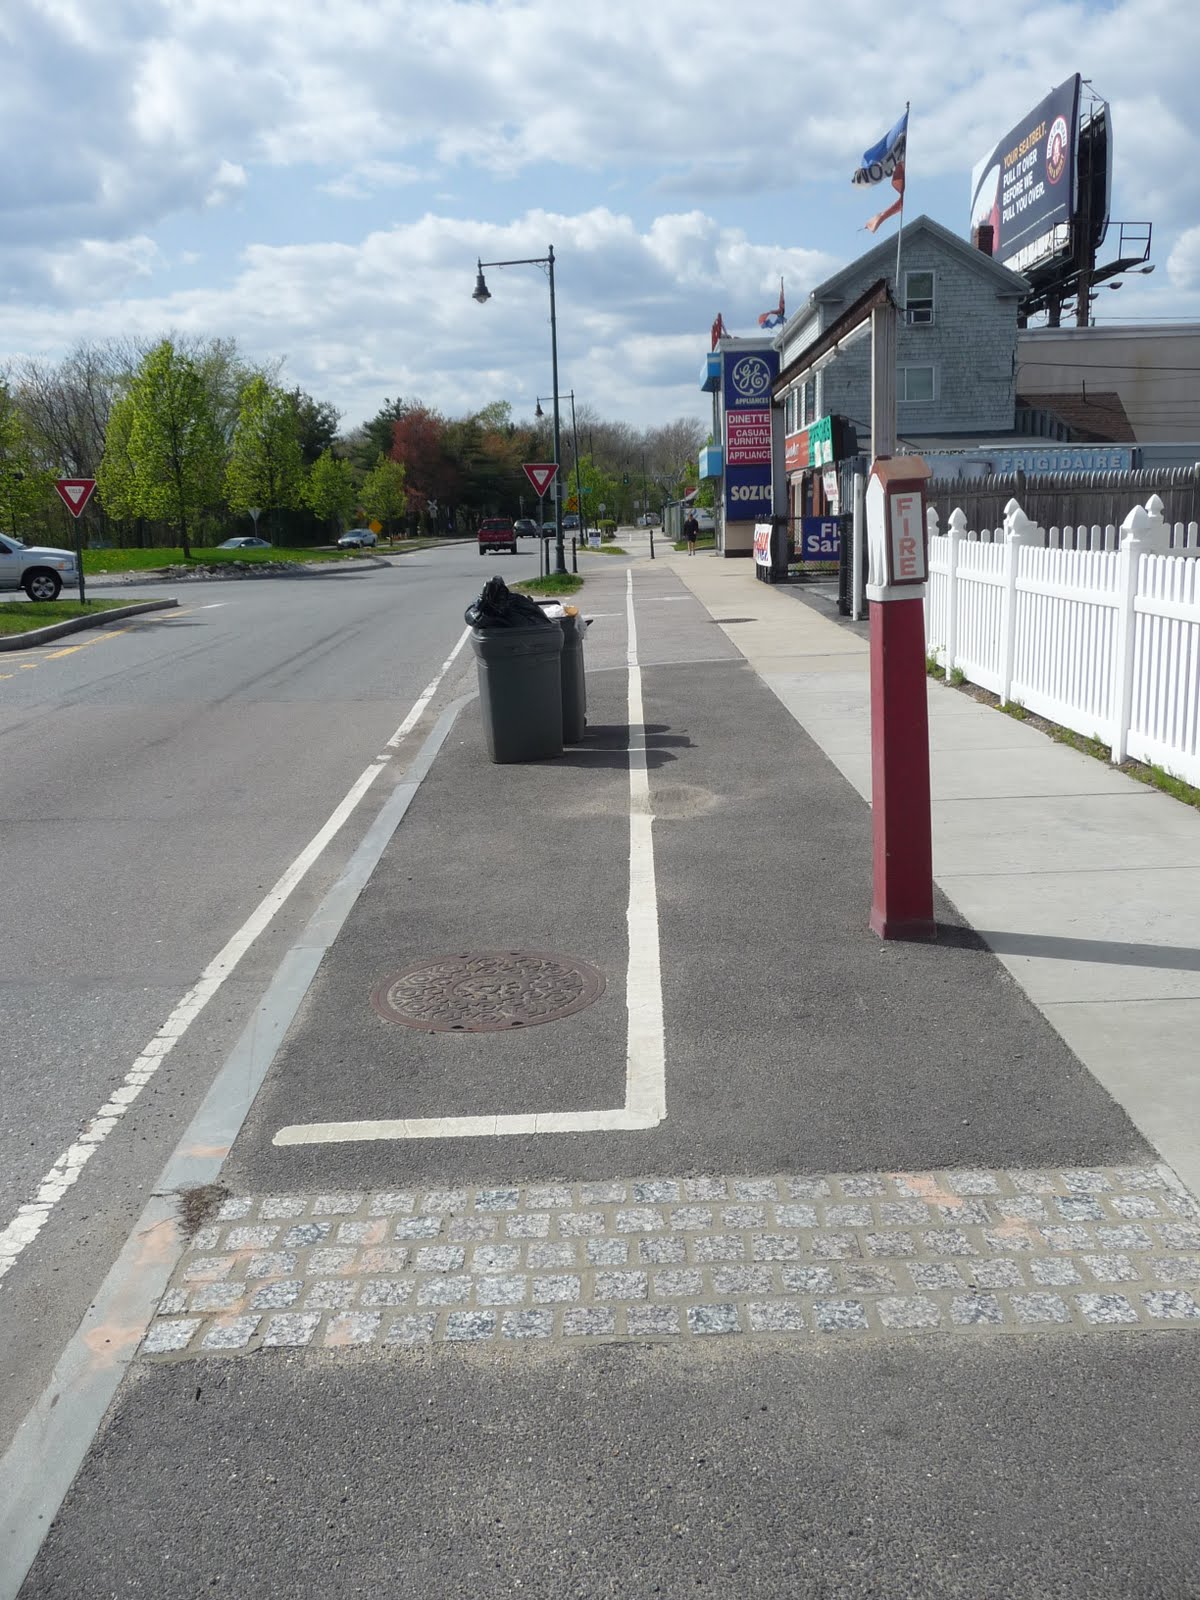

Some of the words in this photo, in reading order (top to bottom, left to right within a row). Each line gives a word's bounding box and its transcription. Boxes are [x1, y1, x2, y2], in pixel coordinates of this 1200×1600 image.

[1004, 147, 1018, 169] YOUR
[1019, 121, 1047, 158] SEATBELT.
[1003, 168, 1016, 188] PULL
[1016, 161, 1022, 178] IT
[1022, 148, 1038, 173] OVER
[1003, 179, 1024, 207] BEFORE
[1023, 170, 1034, 190] WE
[1003, 203, 1016, 224] PULL
[1016, 193, 1028, 214] YOU
[1028, 181, 1045, 205] OVER.
[729, 437, 772, 446] FURNITUR
[735, 429, 770, 437] CASUAL
[1001, 456, 1122, 472] FRIGIDAIRE
[896, 497, 917, 576] FIRE
